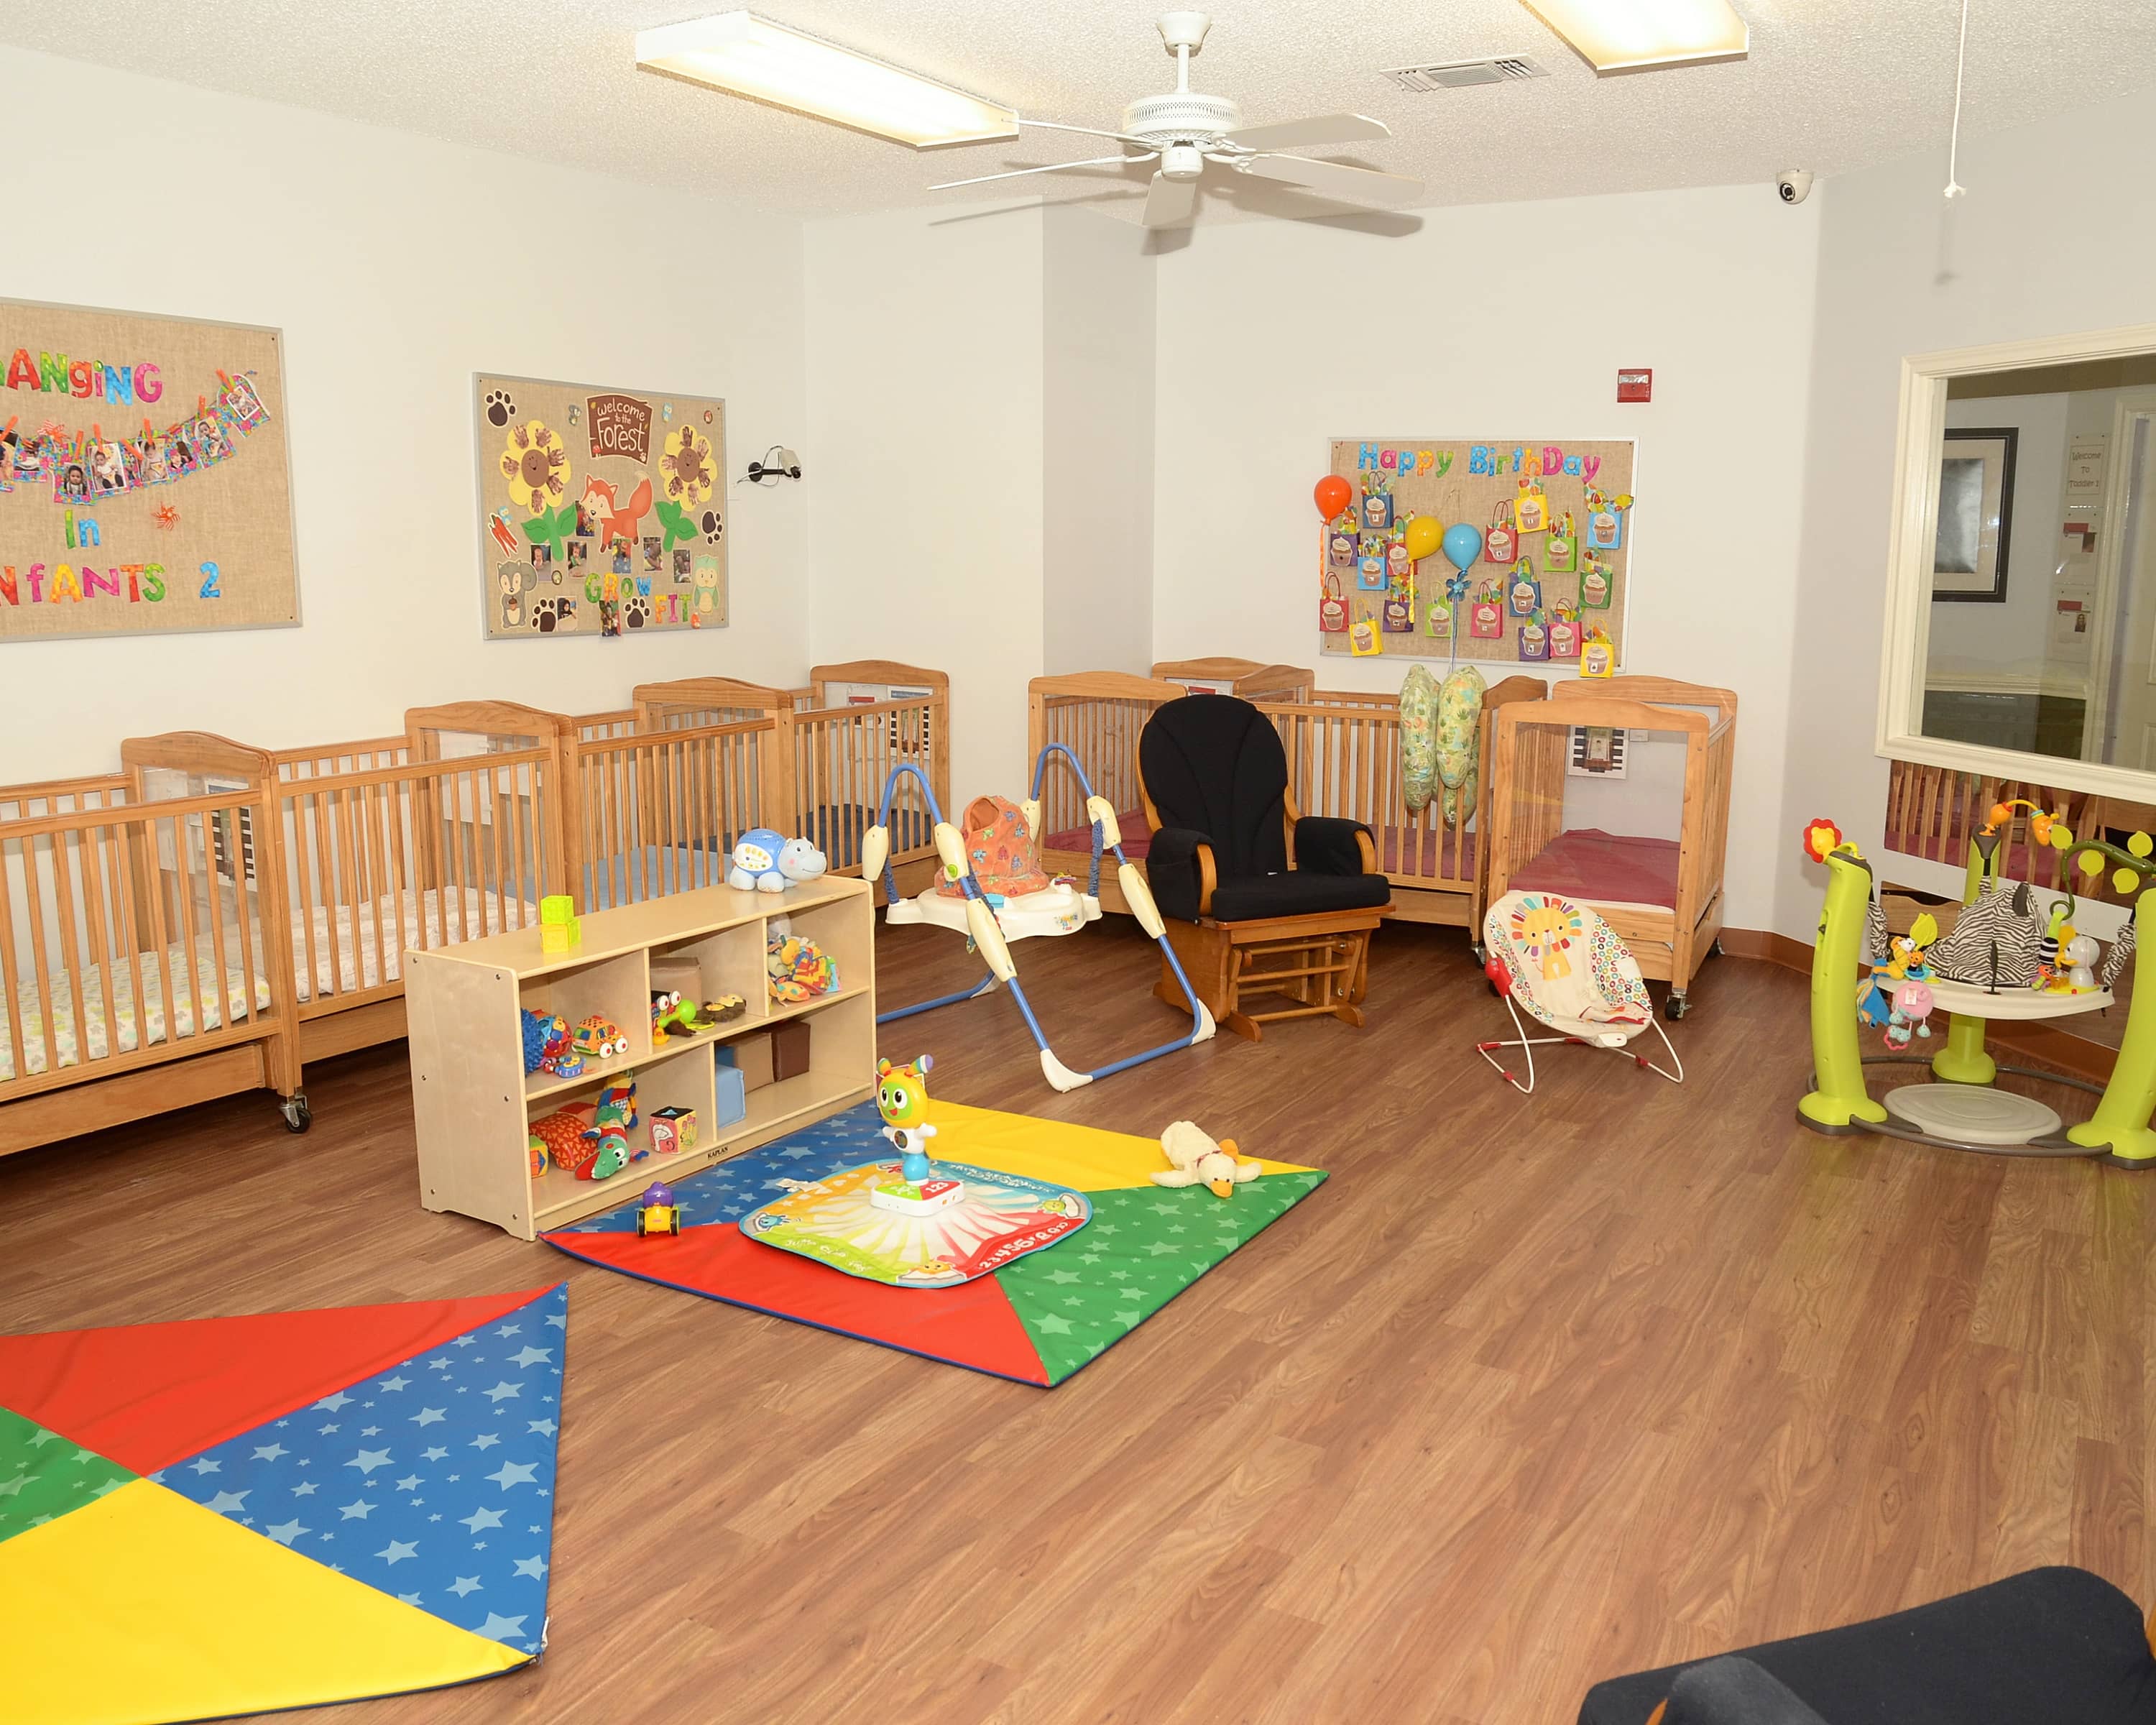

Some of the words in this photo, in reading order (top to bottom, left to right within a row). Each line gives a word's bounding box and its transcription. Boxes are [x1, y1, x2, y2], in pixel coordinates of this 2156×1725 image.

[0, 348, 162, 405] ANgiNG
[597, 397, 645, 421] welcome
[614, 413, 621, 423] to
[621, 413, 632, 424] the
[596, 417, 645, 452] Forest
[1358, 442, 1455, 479] Happy
[1468, 445, 1601, 484] BirthDay
[199, 561, 221, 599] 2
[584, 572, 652, 604] GROW
[655, 594, 691, 624] FIT
[925, 1182, 949, 1192] 123
